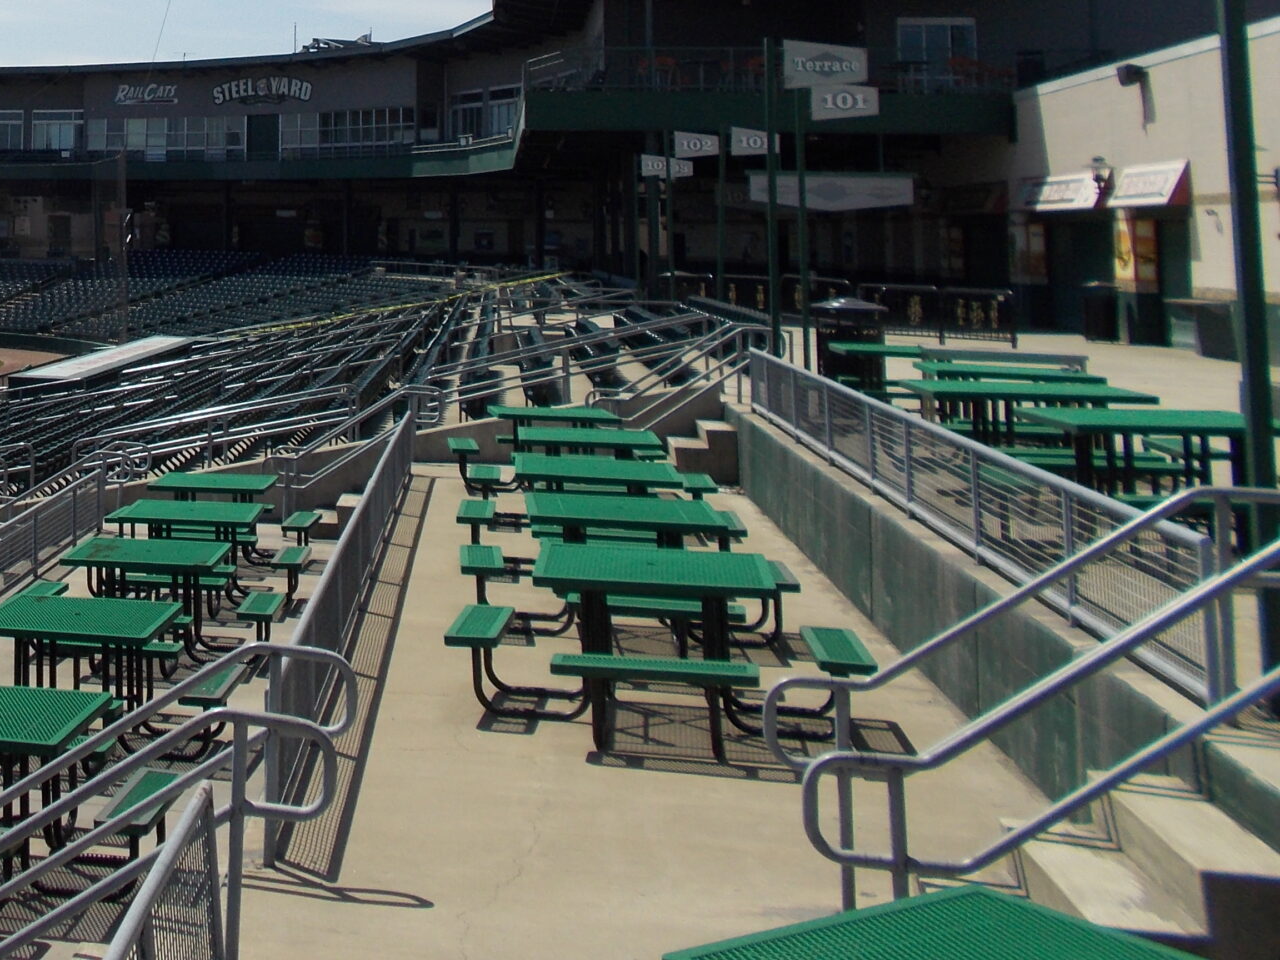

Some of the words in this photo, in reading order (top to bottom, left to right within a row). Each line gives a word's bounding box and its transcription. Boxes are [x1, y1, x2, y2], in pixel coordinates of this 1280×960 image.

[793, 55, 859, 72] Terrace
[213, 78, 256, 105] STEEL
[269, 76, 312, 101] YARD
[823, 92, 867, 110] 101
[681, 138, 713, 151] 102
